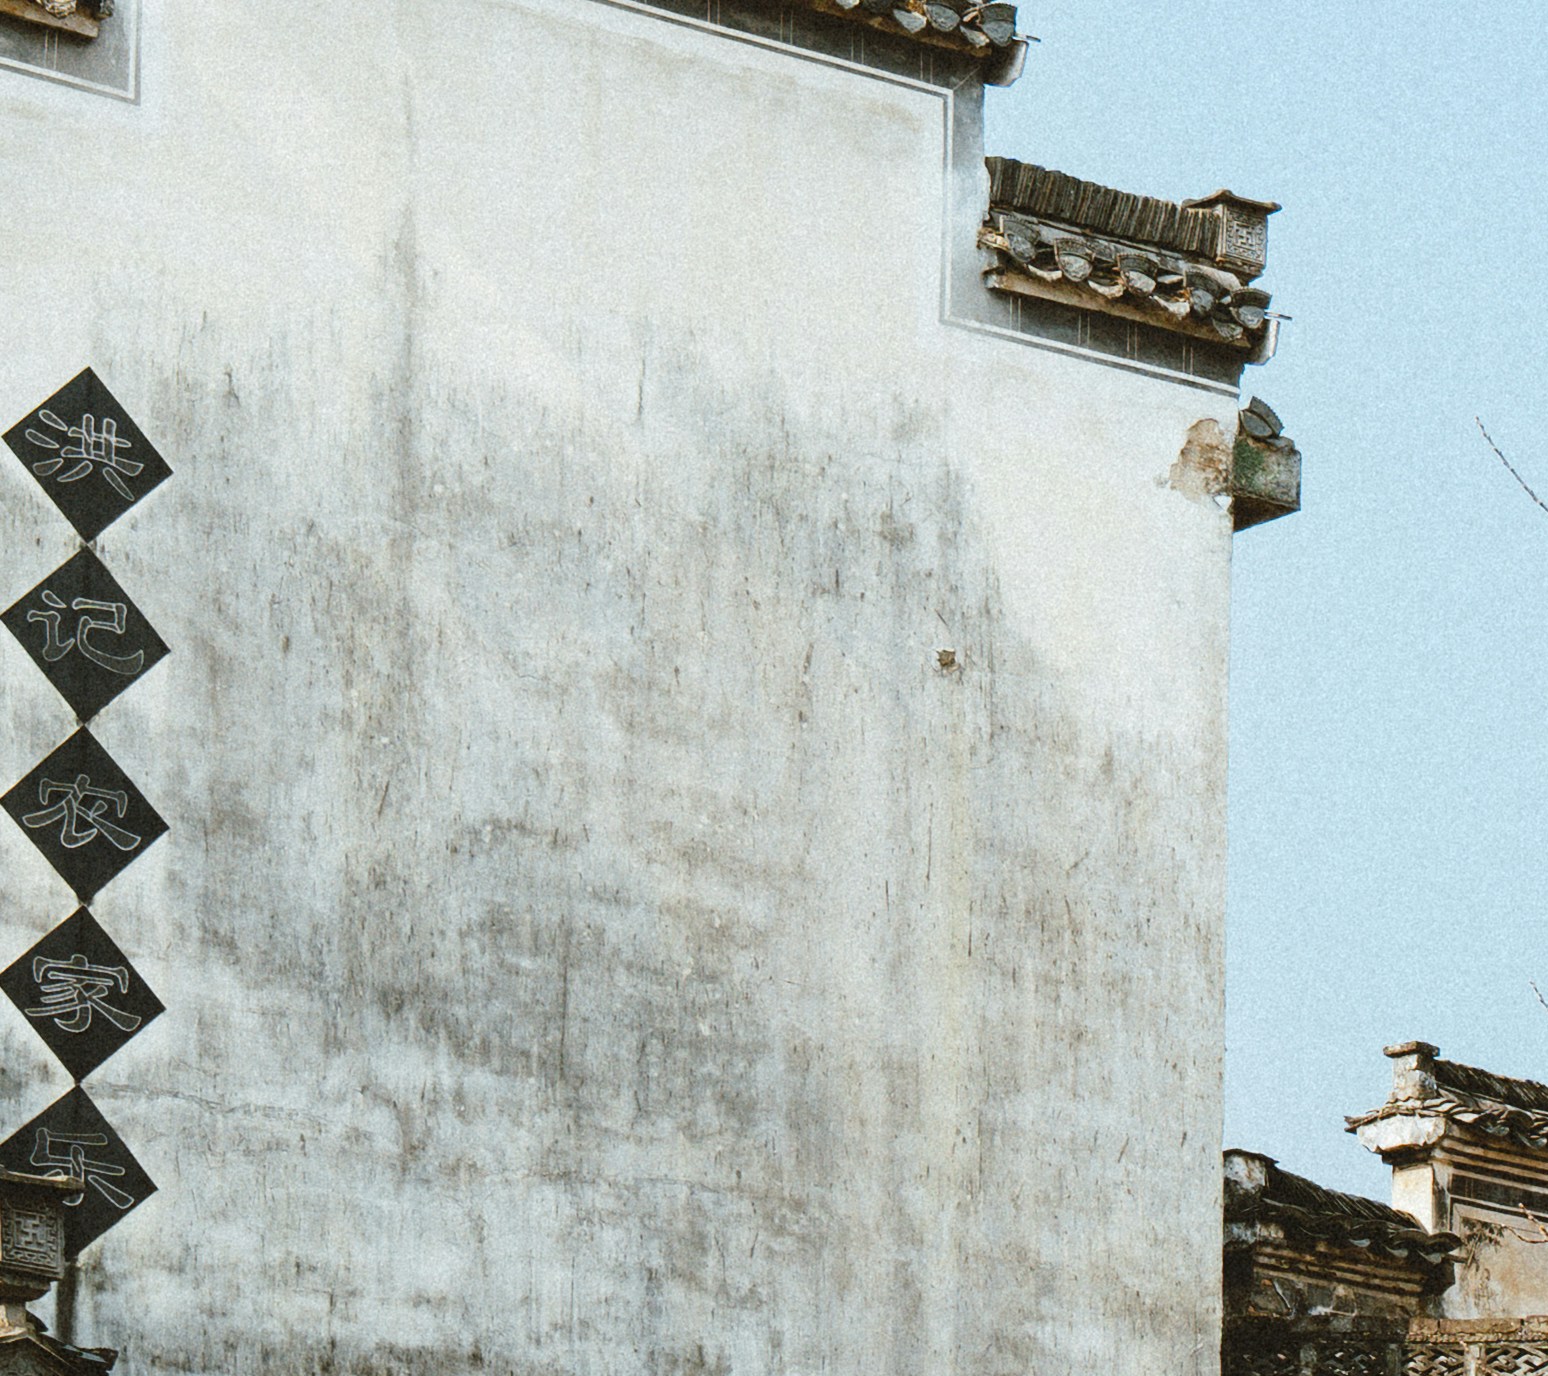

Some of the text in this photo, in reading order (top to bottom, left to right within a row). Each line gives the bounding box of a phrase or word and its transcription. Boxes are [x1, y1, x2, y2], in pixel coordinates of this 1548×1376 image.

[25, 409, 144, 1208] 洪记农家乐
